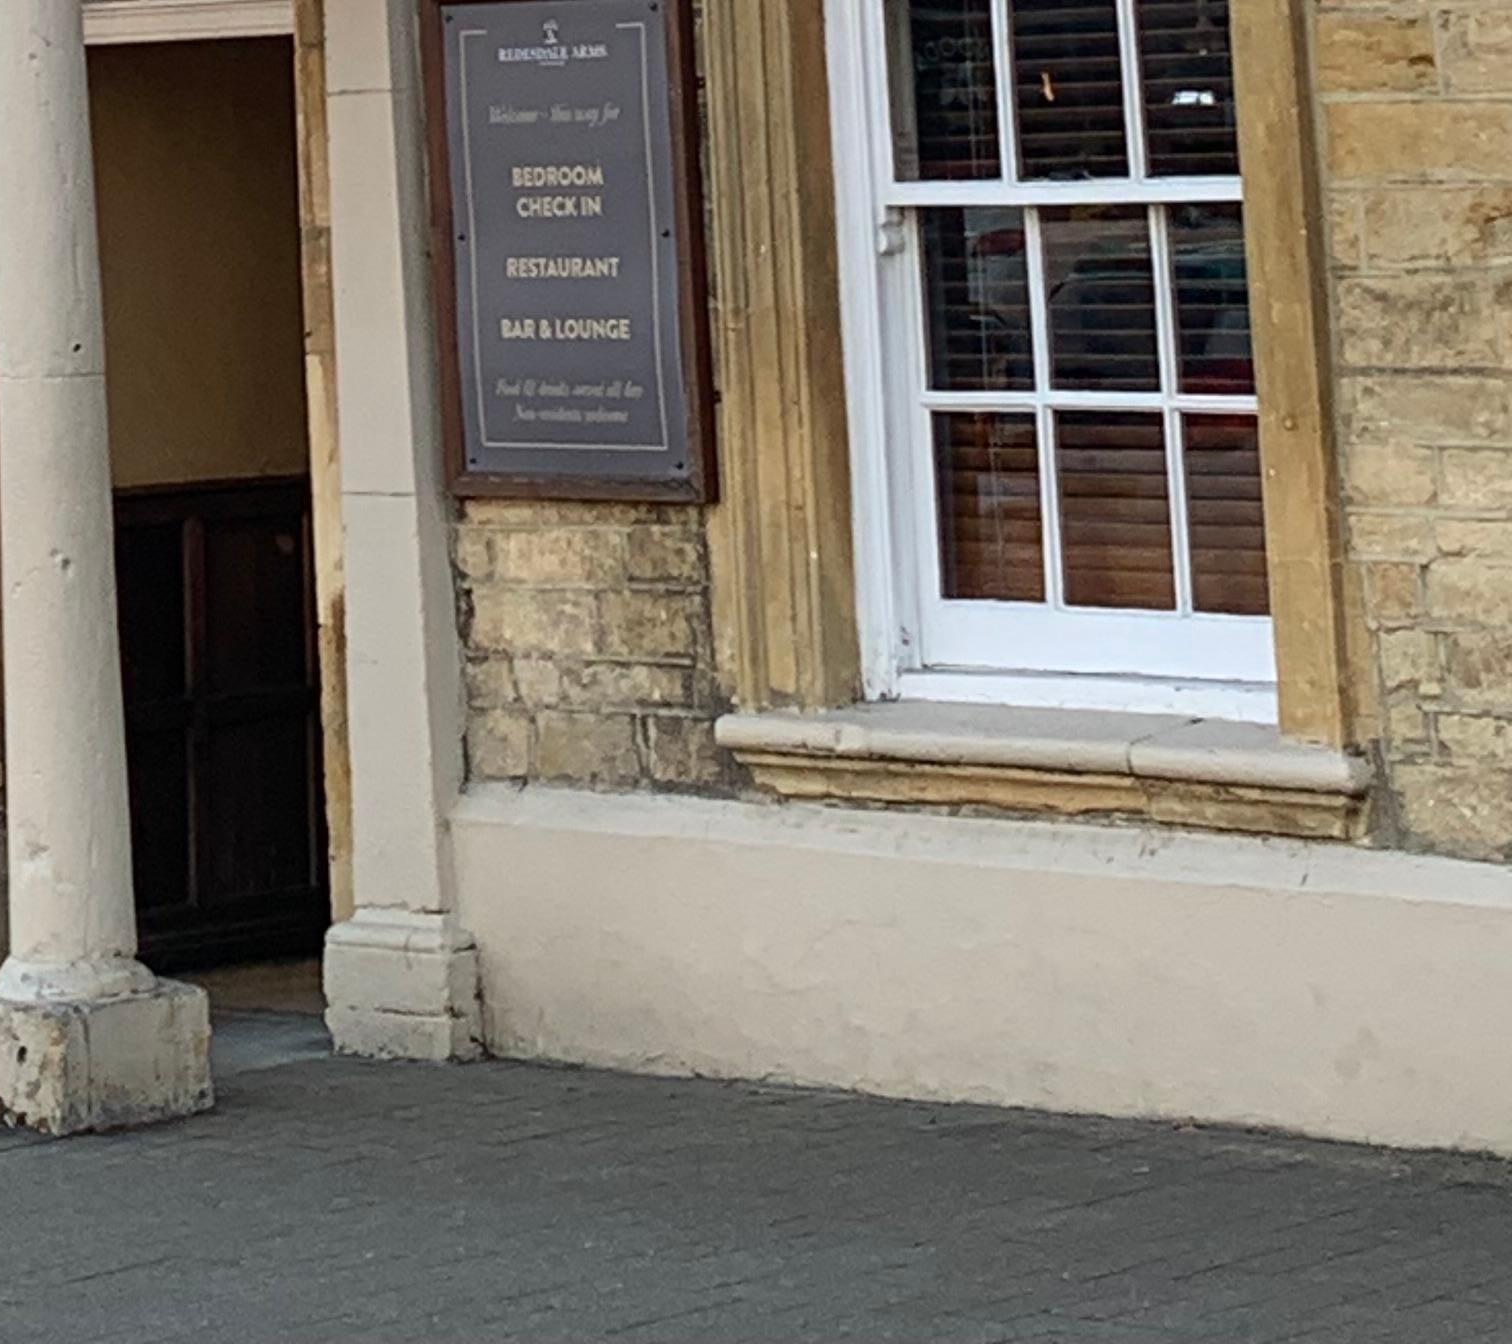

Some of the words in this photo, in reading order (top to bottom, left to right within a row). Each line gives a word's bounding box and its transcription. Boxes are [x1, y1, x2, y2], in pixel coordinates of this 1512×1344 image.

[571, 43, 609, 59] ARMS
[512, 165, 604, 188] BEDROOM
[516, 195, 578, 218] CHECK
[580, 195, 603, 217] IN
[506, 257, 620, 278] RESTAURANT
[500, 318, 535, 340] BAR
[539, 319, 553, 340] &
[555, 318, 631, 340] LOUNGE
